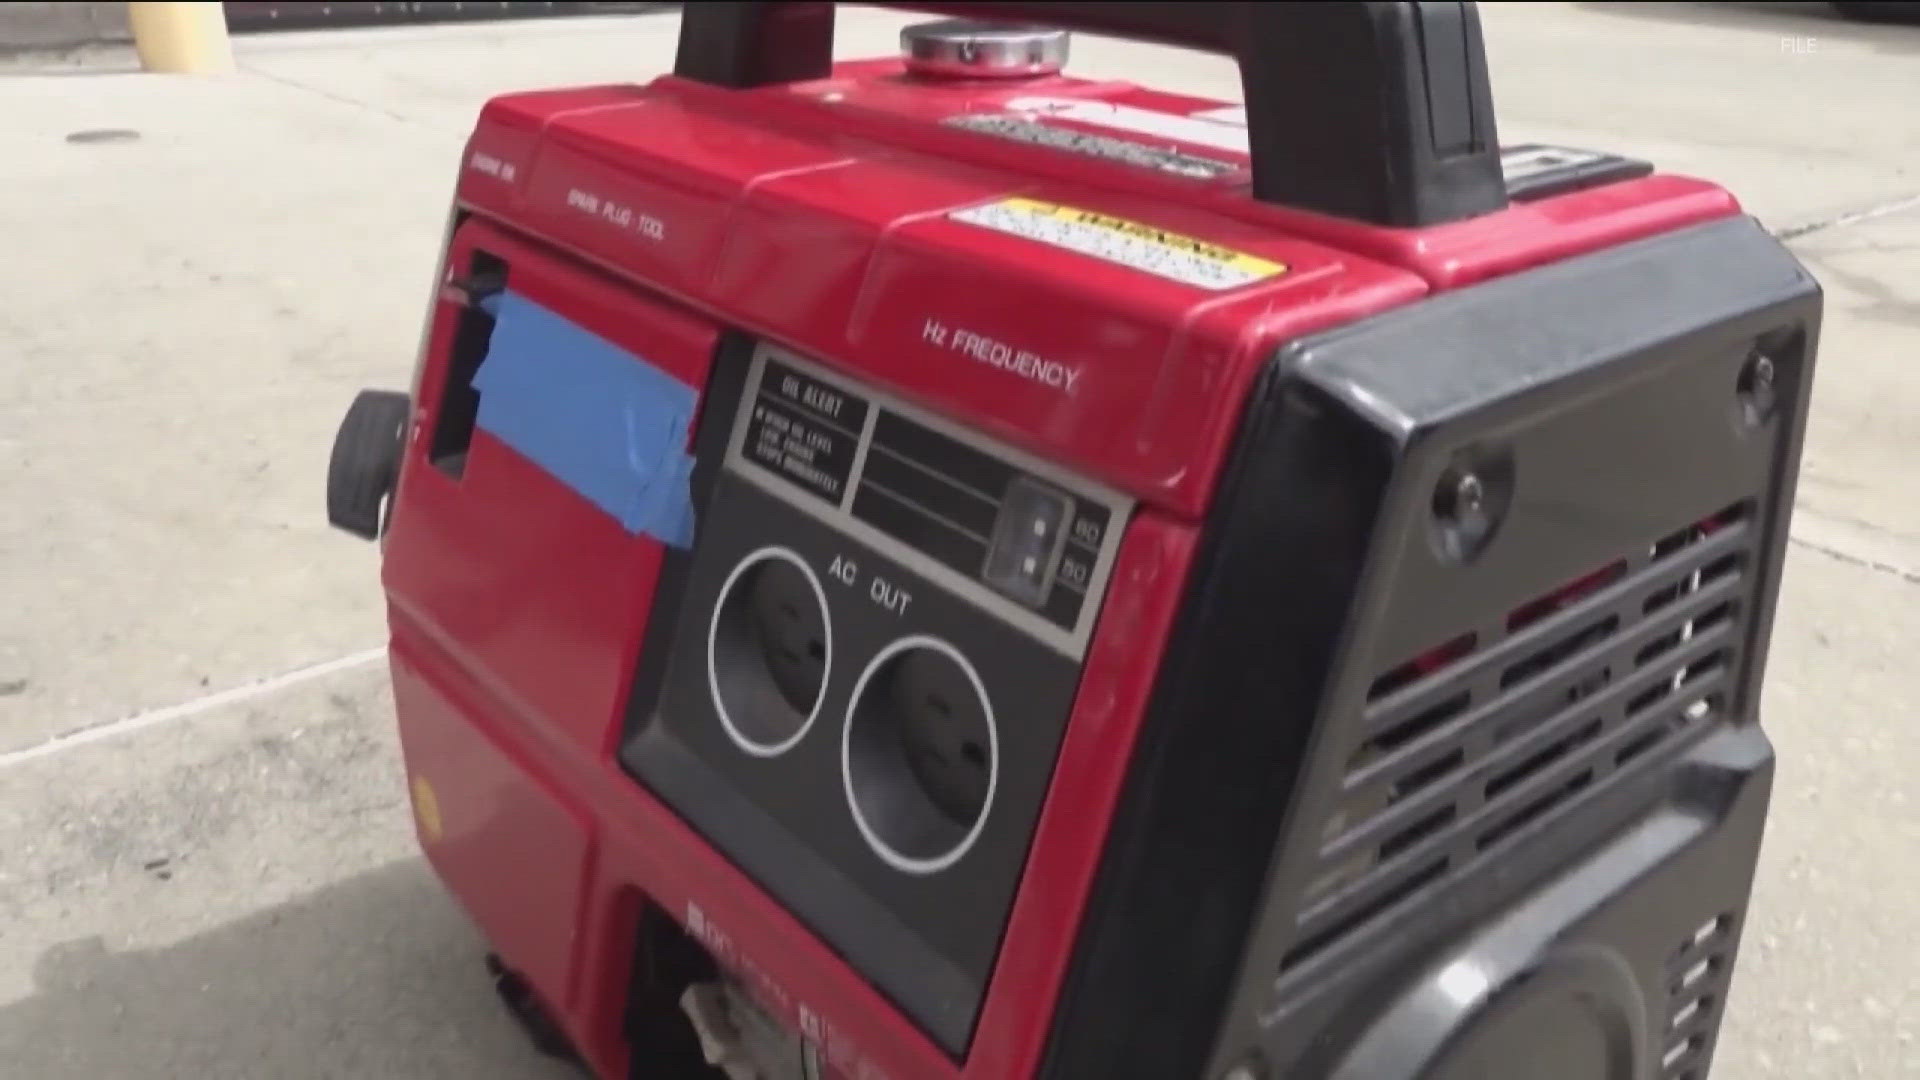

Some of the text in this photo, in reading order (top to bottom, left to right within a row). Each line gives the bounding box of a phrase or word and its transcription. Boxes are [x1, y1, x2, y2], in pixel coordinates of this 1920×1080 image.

[602, 200, 632, 228] PLUG
[638, 213, 665, 241] TOOL
[922, 316, 1081, 392] Hz FREQUENCY
[802, 384, 843, 418] ALERT
[828, 554, 912, 616] AC OUT
